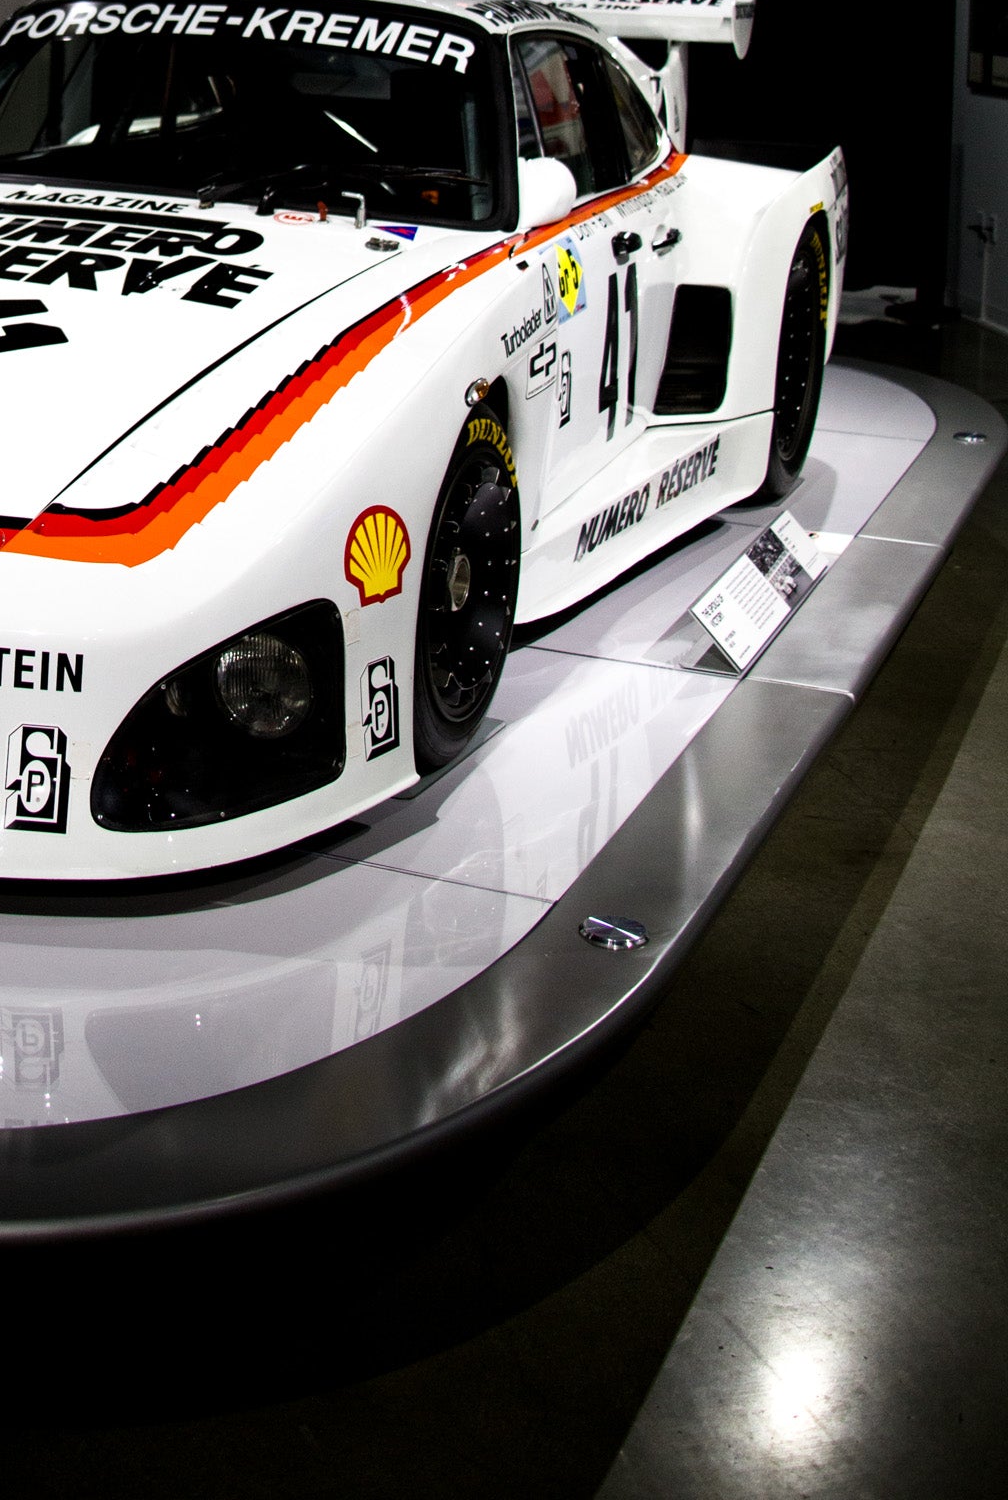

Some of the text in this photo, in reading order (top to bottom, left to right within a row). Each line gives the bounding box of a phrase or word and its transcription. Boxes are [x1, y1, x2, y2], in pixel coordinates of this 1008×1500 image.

[0, 1, 476, 75] PORSCHE-KREMER
[5, 190, 189, 214] MAGAZINE
[500, 307, 543, 359] Turbolader
[598, 262, 639, 442] 41
[572, 481, 651, 563] NUMERO
